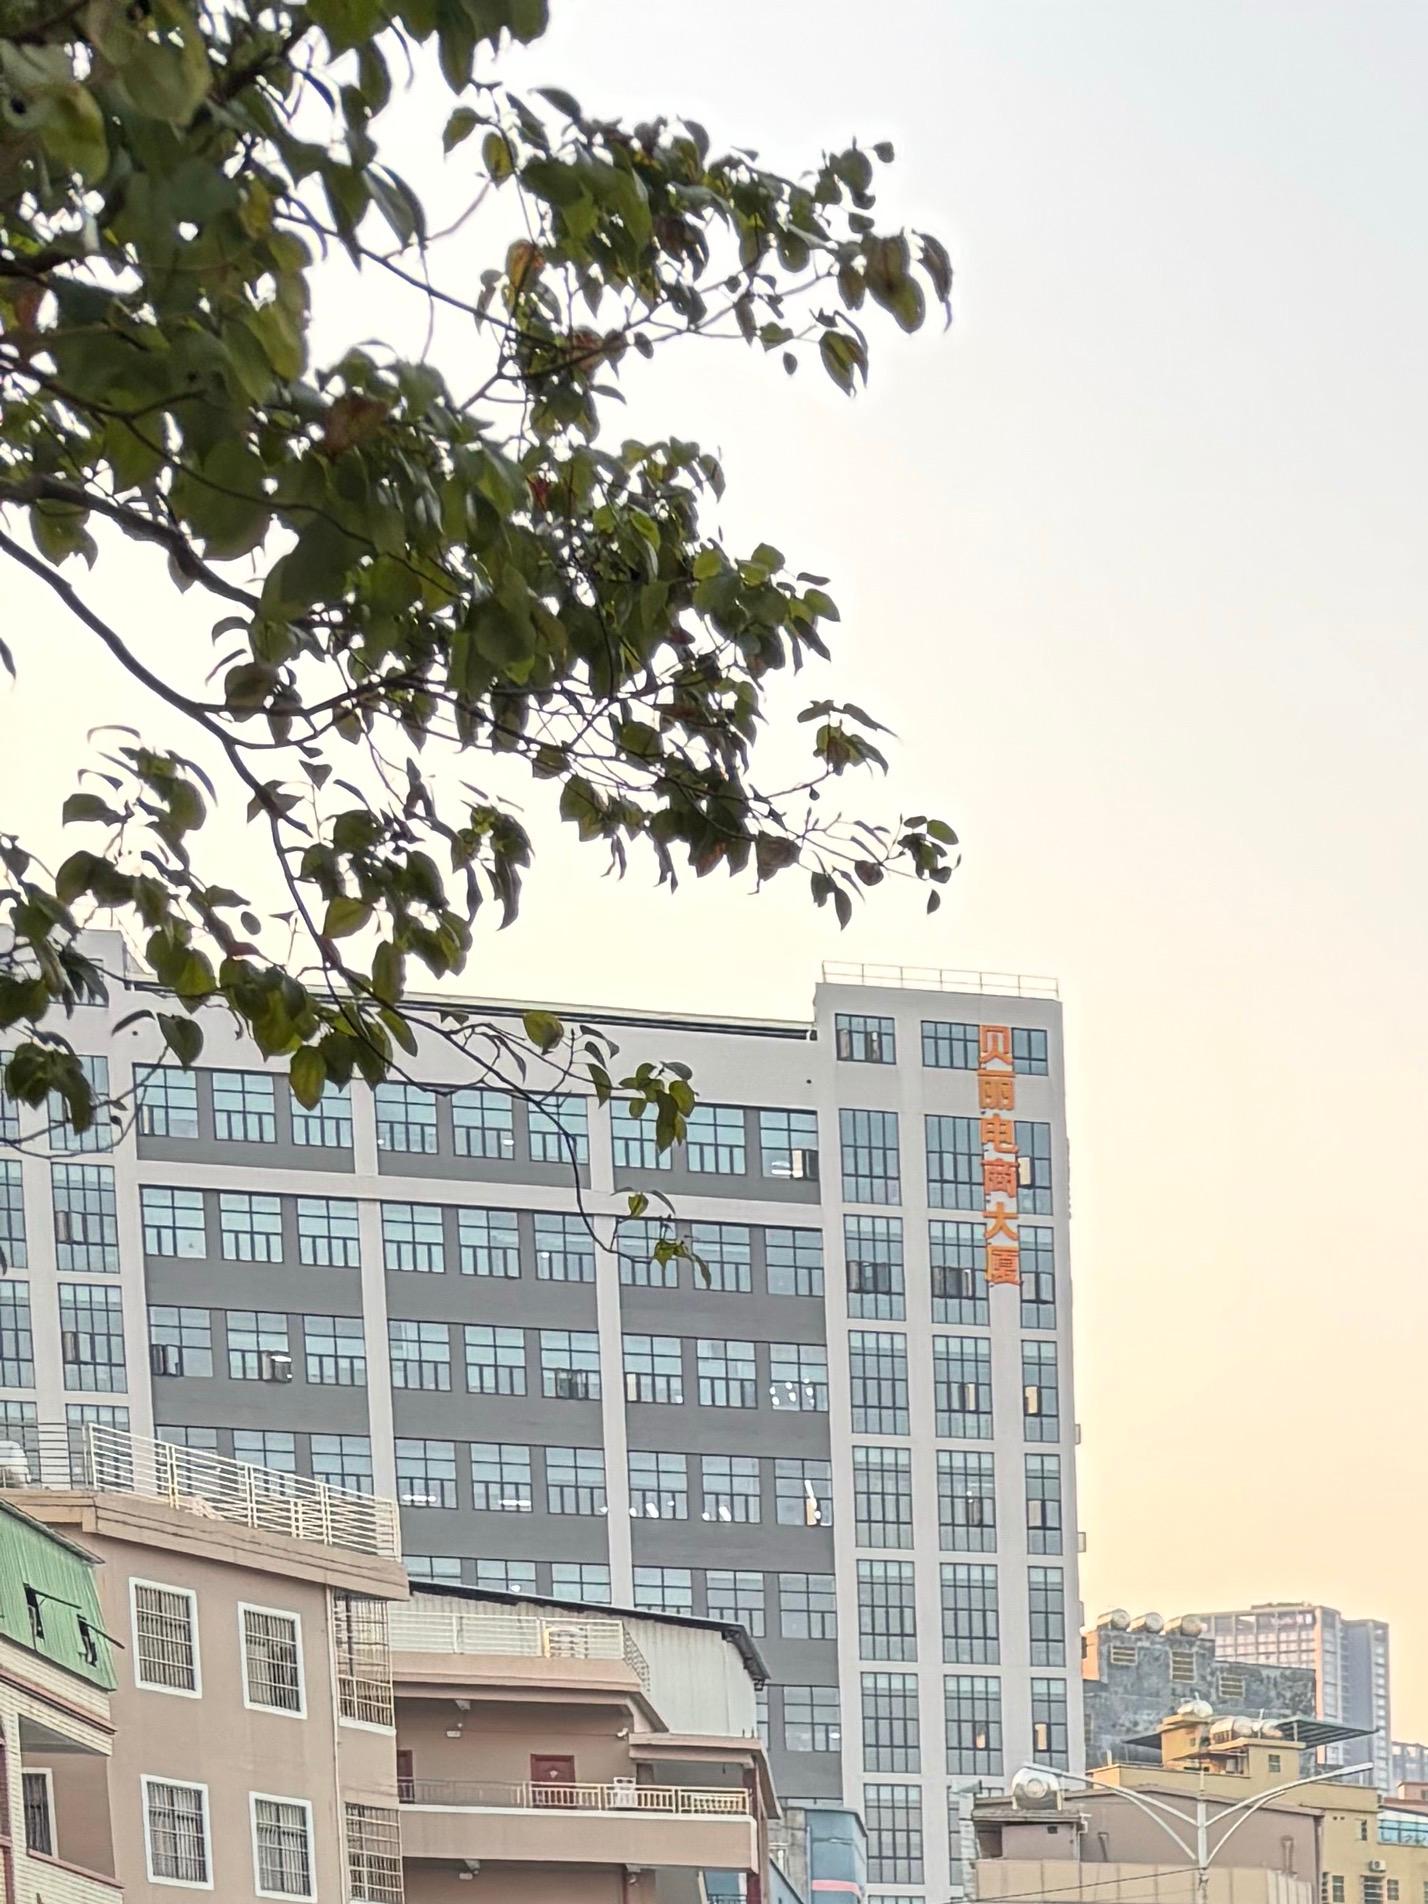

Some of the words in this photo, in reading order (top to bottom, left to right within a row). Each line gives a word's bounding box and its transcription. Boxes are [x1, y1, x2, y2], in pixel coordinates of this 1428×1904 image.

[977, 1024, 1022, 1286] 贝丽电商大厦
